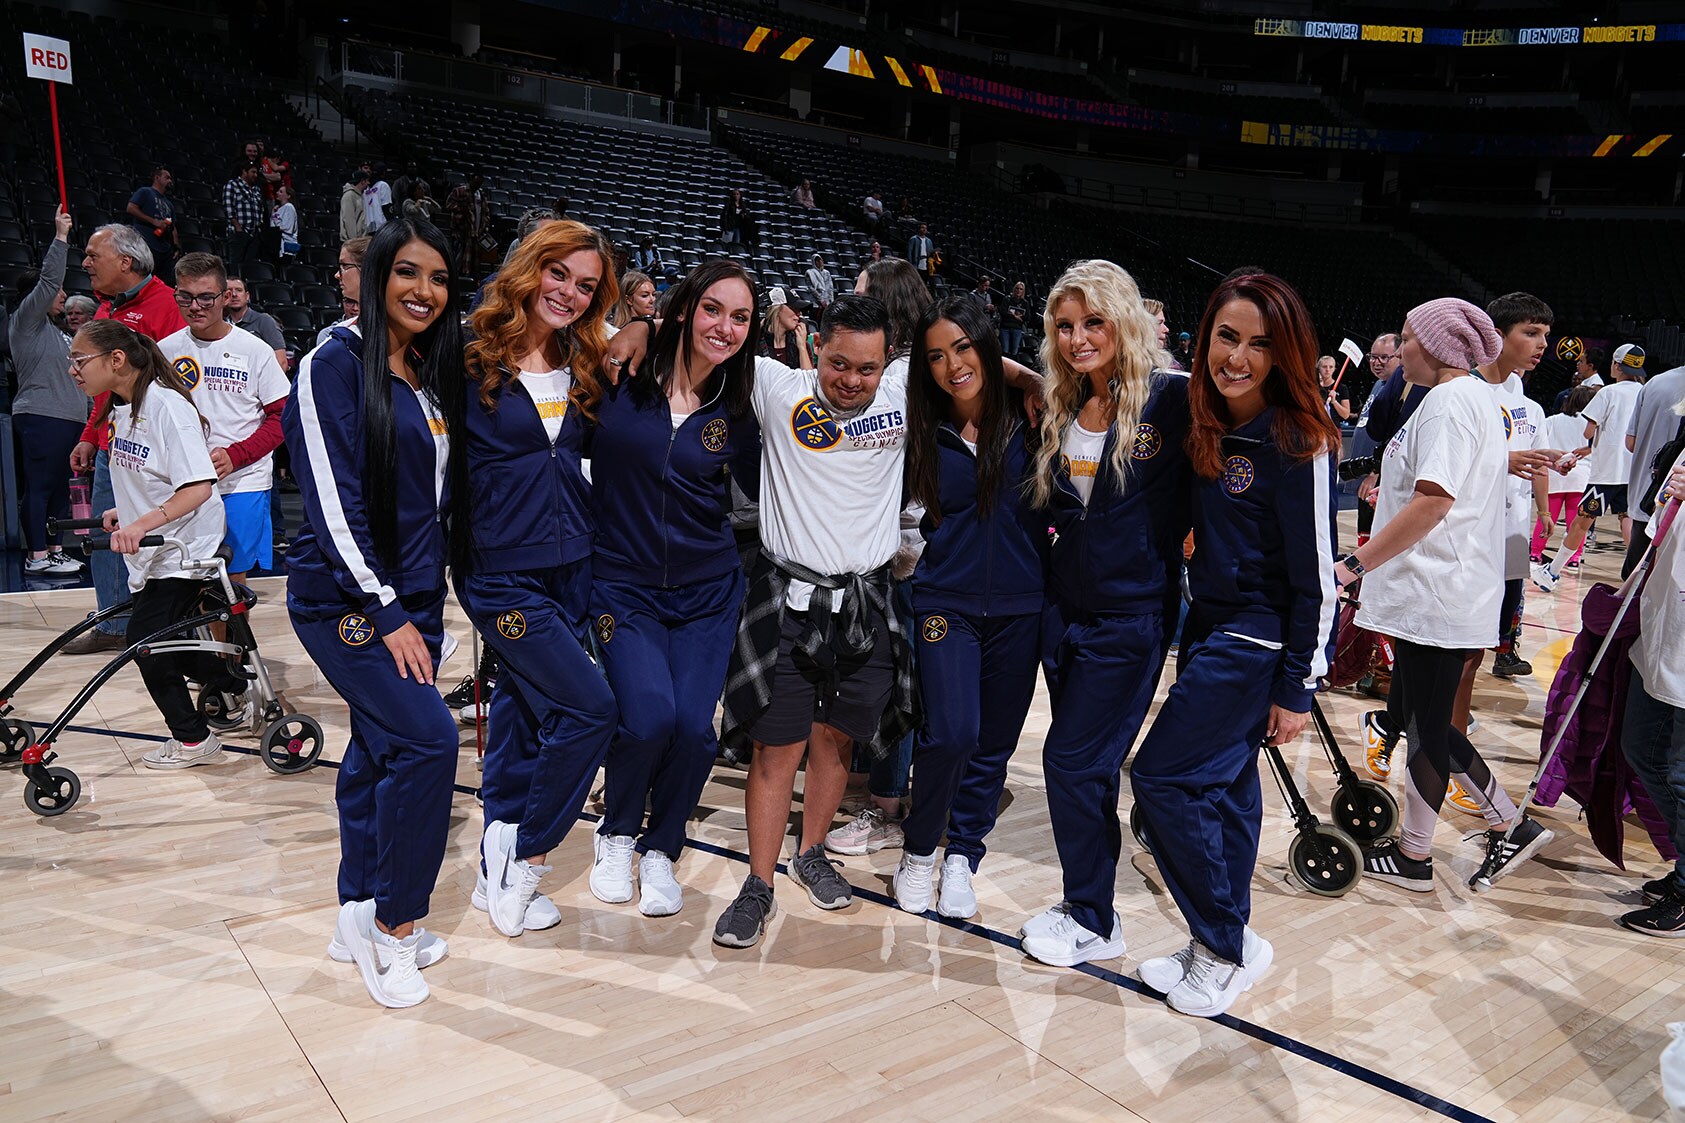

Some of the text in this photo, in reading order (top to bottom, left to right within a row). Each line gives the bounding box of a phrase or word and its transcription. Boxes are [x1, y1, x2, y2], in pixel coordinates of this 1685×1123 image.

[1305, 21, 1424, 43] DENVER NUGGETS
[1518, 25, 1656, 45] DENVER NUGGETS
[31, 47, 68, 71] RED
[507, 74, 521, 84] 102
[204, 366, 249, 382] NUGGETS
[207, 383, 242, 394] CLINIC
[223, 379, 248, 388] OLYMPICS
[843, 410, 904, 438] NUGGETS
[848, 427, 905, 442] SPECIAL OLYMPICS
[114, 436, 151, 459] NUGGETS
[853, 437, 898, 449] CLINIC
[116, 457, 140, 473] CLINIC
